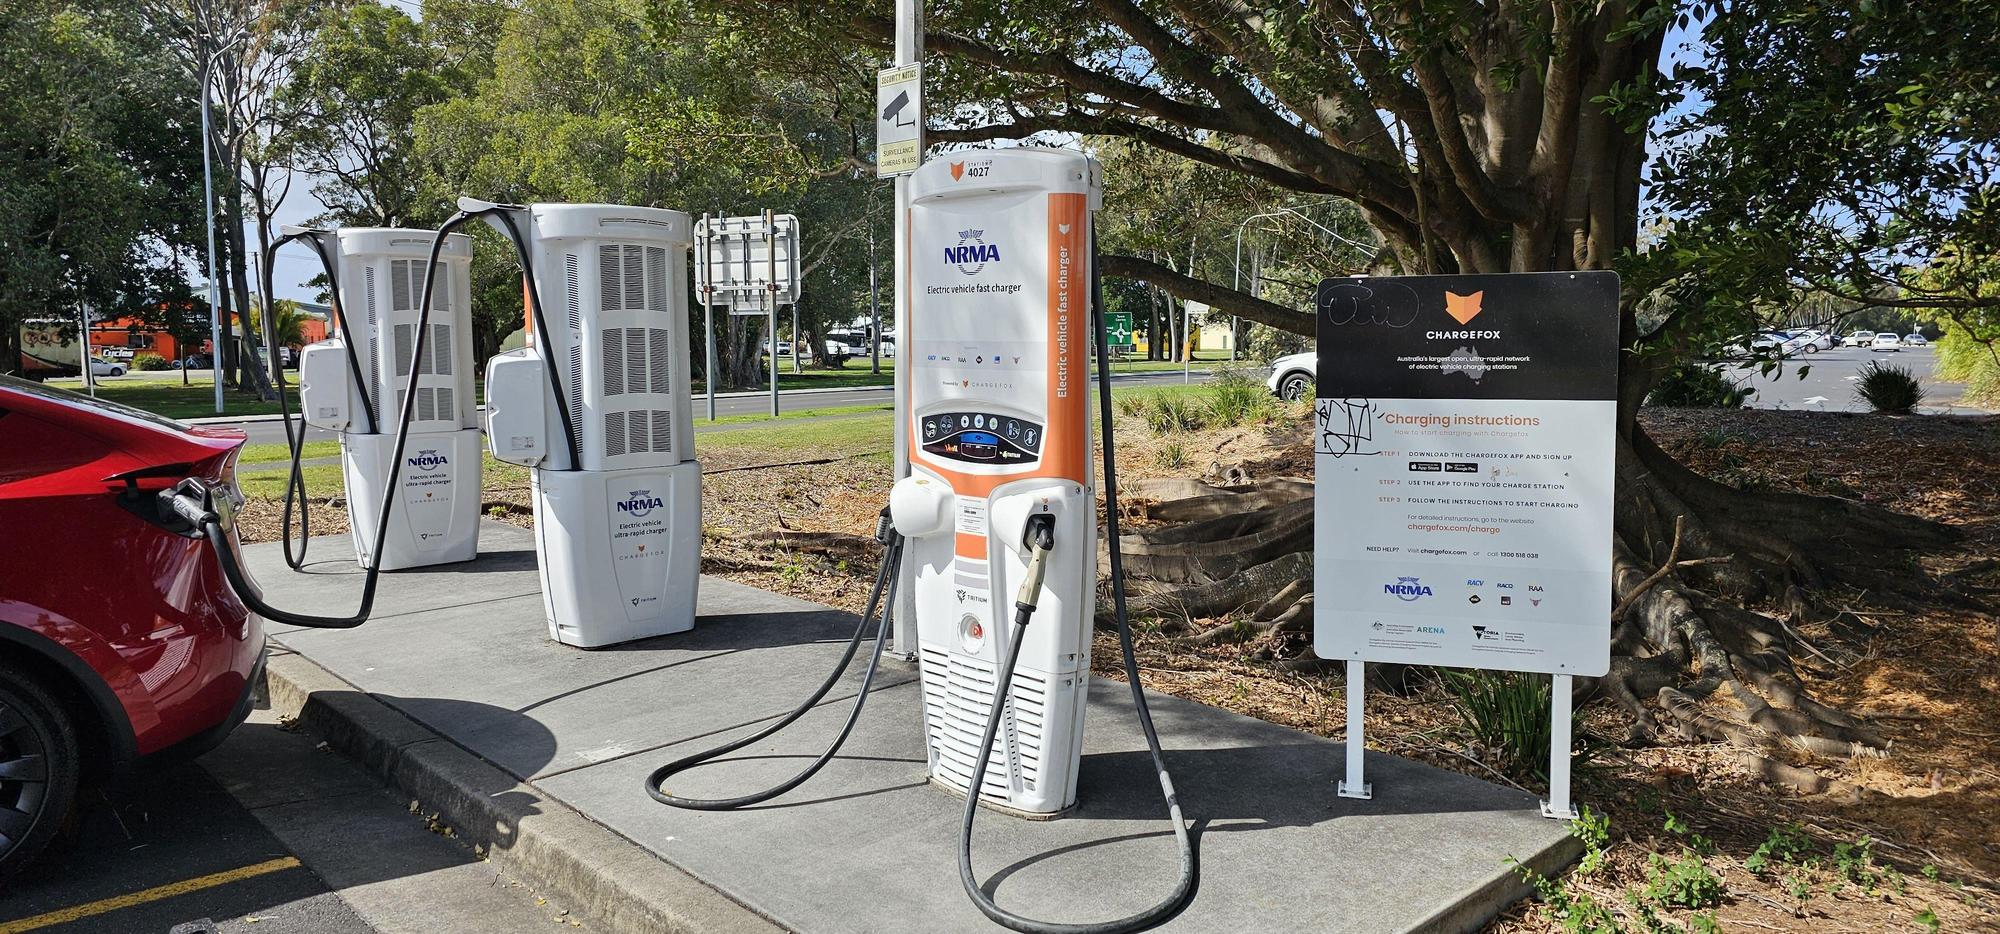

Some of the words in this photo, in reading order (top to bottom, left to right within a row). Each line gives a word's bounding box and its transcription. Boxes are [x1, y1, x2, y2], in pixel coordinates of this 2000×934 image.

[882, 73, 901, 84] SECURITY
[902, 69, 916, 80] NOTICE
[883, 146, 914, 157] SURVEILLANCE
[881, 158, 900, 167] CAMERAS
[968, 166, 989, 177] 4027
[944, 245, 1000, 264] NRMA
[1058, 246, 1070, 289] charger
[928, 286, 950, 294] Electric
[951, 284, 975, 293] vehicle
[976, 283, 990, 292] fast
[992, 283, 1022, 294] charger
[1057, 291, 1068, 313] fast
[1057, 315, 1067, 354] vehicle
[1426, 331, 1500, 339] CHARGEFOX
[1057, 357, 1067, 398] Electric
[1386, 414, 1450, 427] Charging
[1454, 414, 1540, 426] instructions
[408, 456, 448, 466] NRMA
[617, 498, 664, 512] NRMA
[614, 530, 645, 538] ultra-rapid
[1408, 524, 1500, 534] chargefox.com/charge
[1385, 584, 1432, 596] NRMA
[968, 595, 987, 603] TRITIUM
